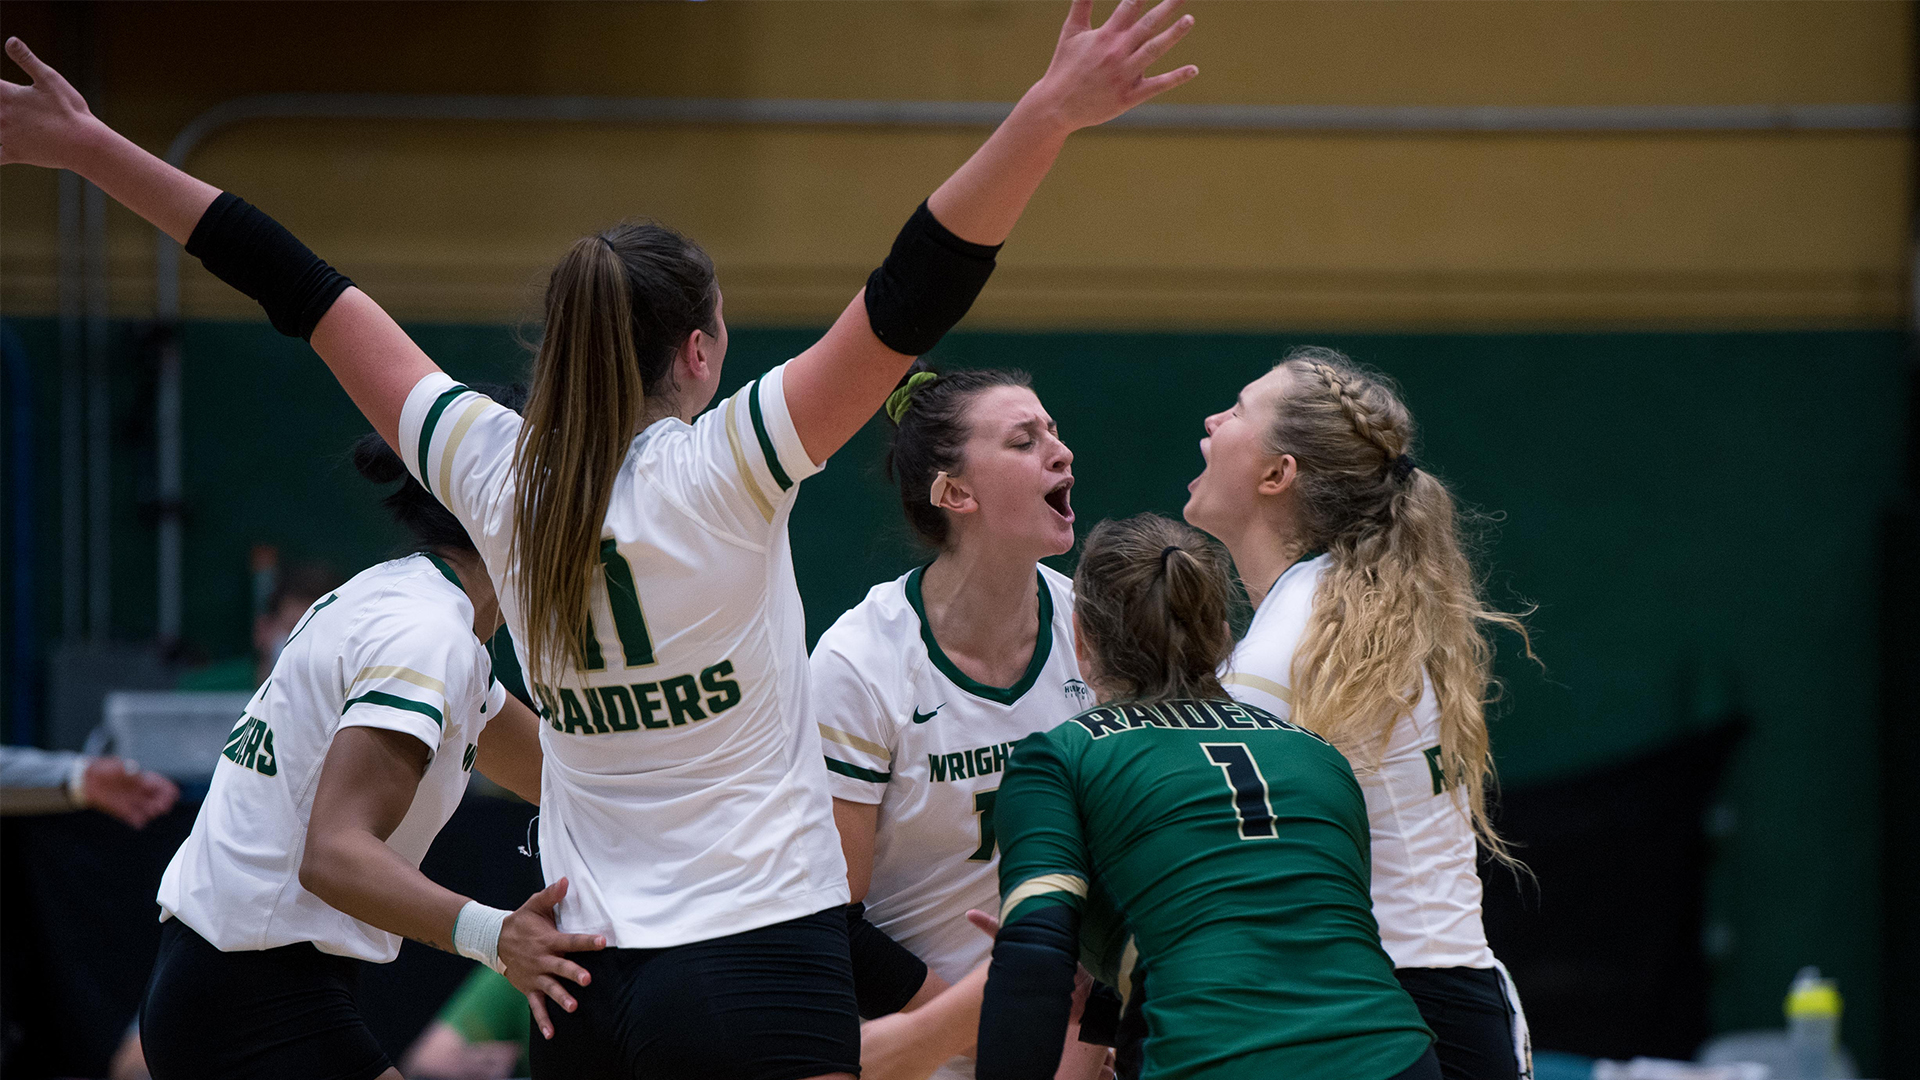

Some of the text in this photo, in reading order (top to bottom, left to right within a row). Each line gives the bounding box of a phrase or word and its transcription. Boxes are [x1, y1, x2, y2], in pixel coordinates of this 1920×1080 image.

[1069, 699, 1330, 746] RAIDER
[928, 740, 1019, 782] WRIGH
[1199, 743, 1279, 840] 1
